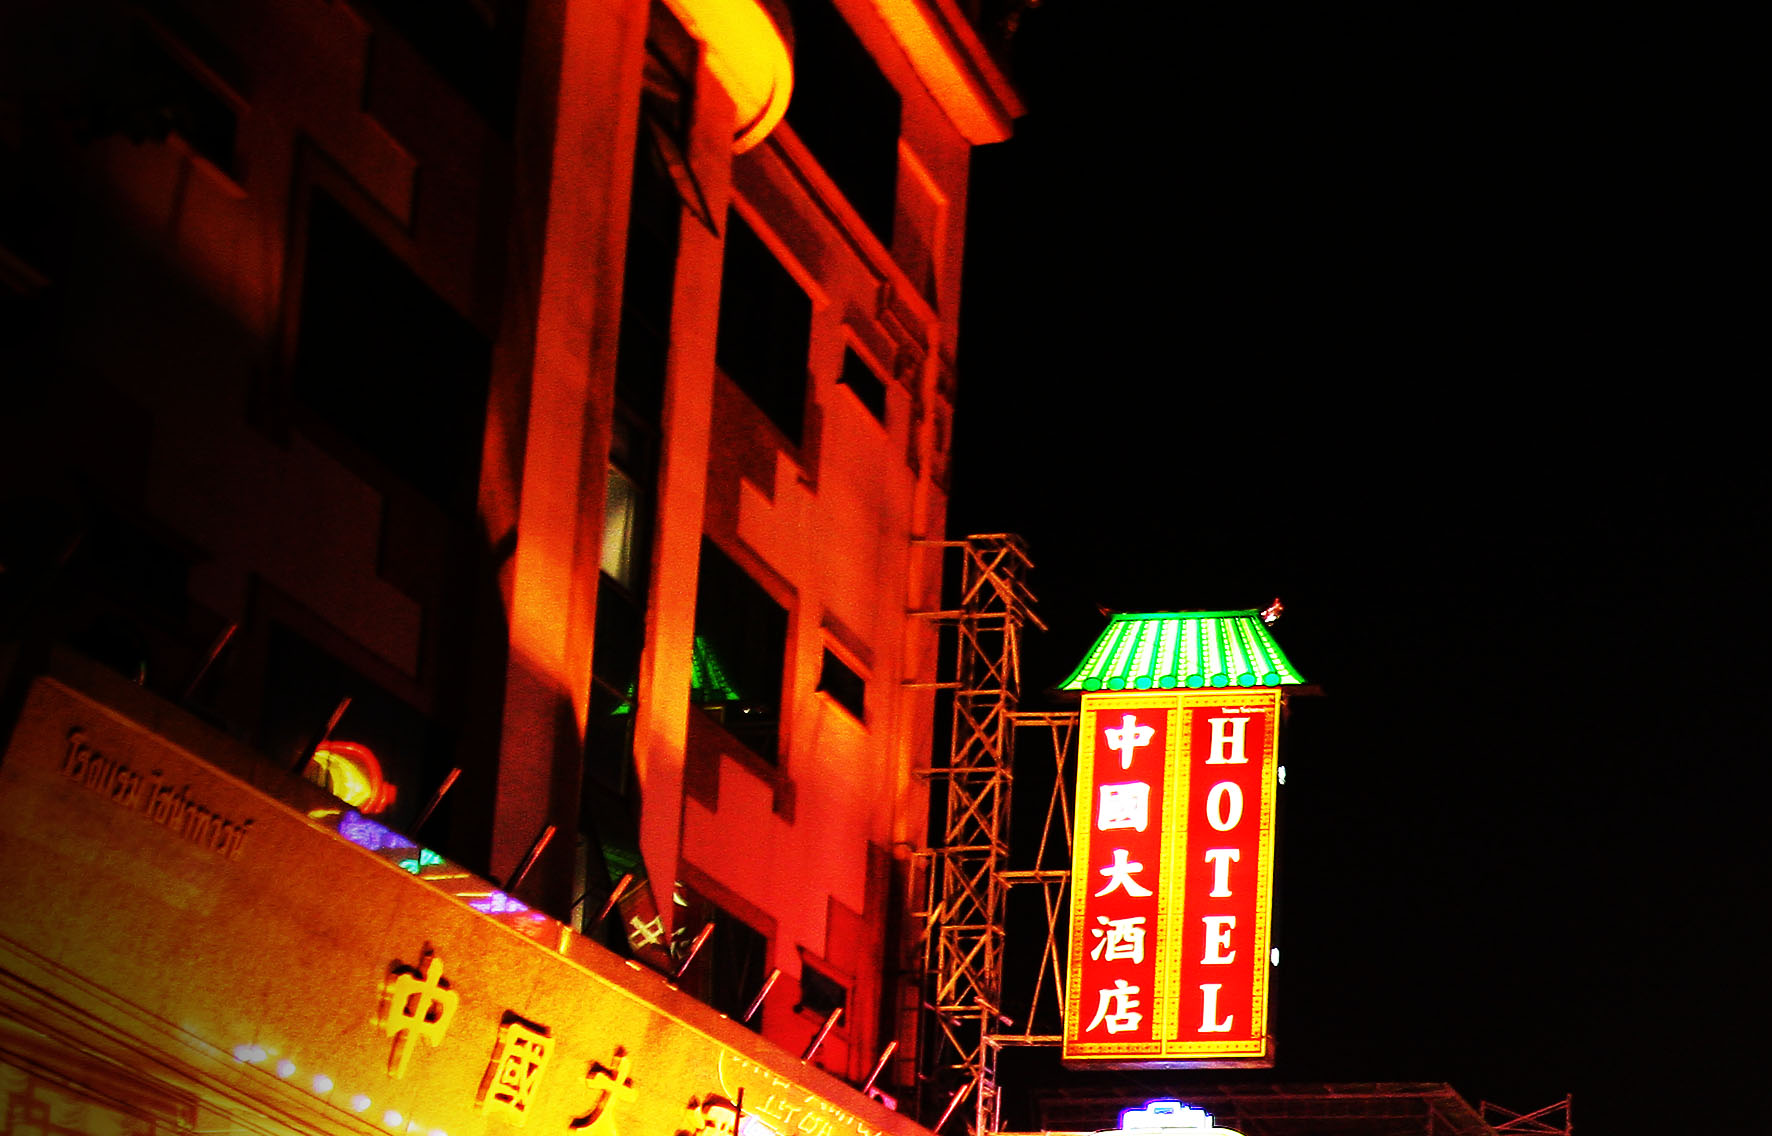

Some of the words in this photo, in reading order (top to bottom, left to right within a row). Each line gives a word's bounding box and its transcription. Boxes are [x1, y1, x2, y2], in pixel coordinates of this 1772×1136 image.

[1085, 714, 1156, 1034] 中國大酒店
[1197, 717, 1250, 1034] HOTEL
